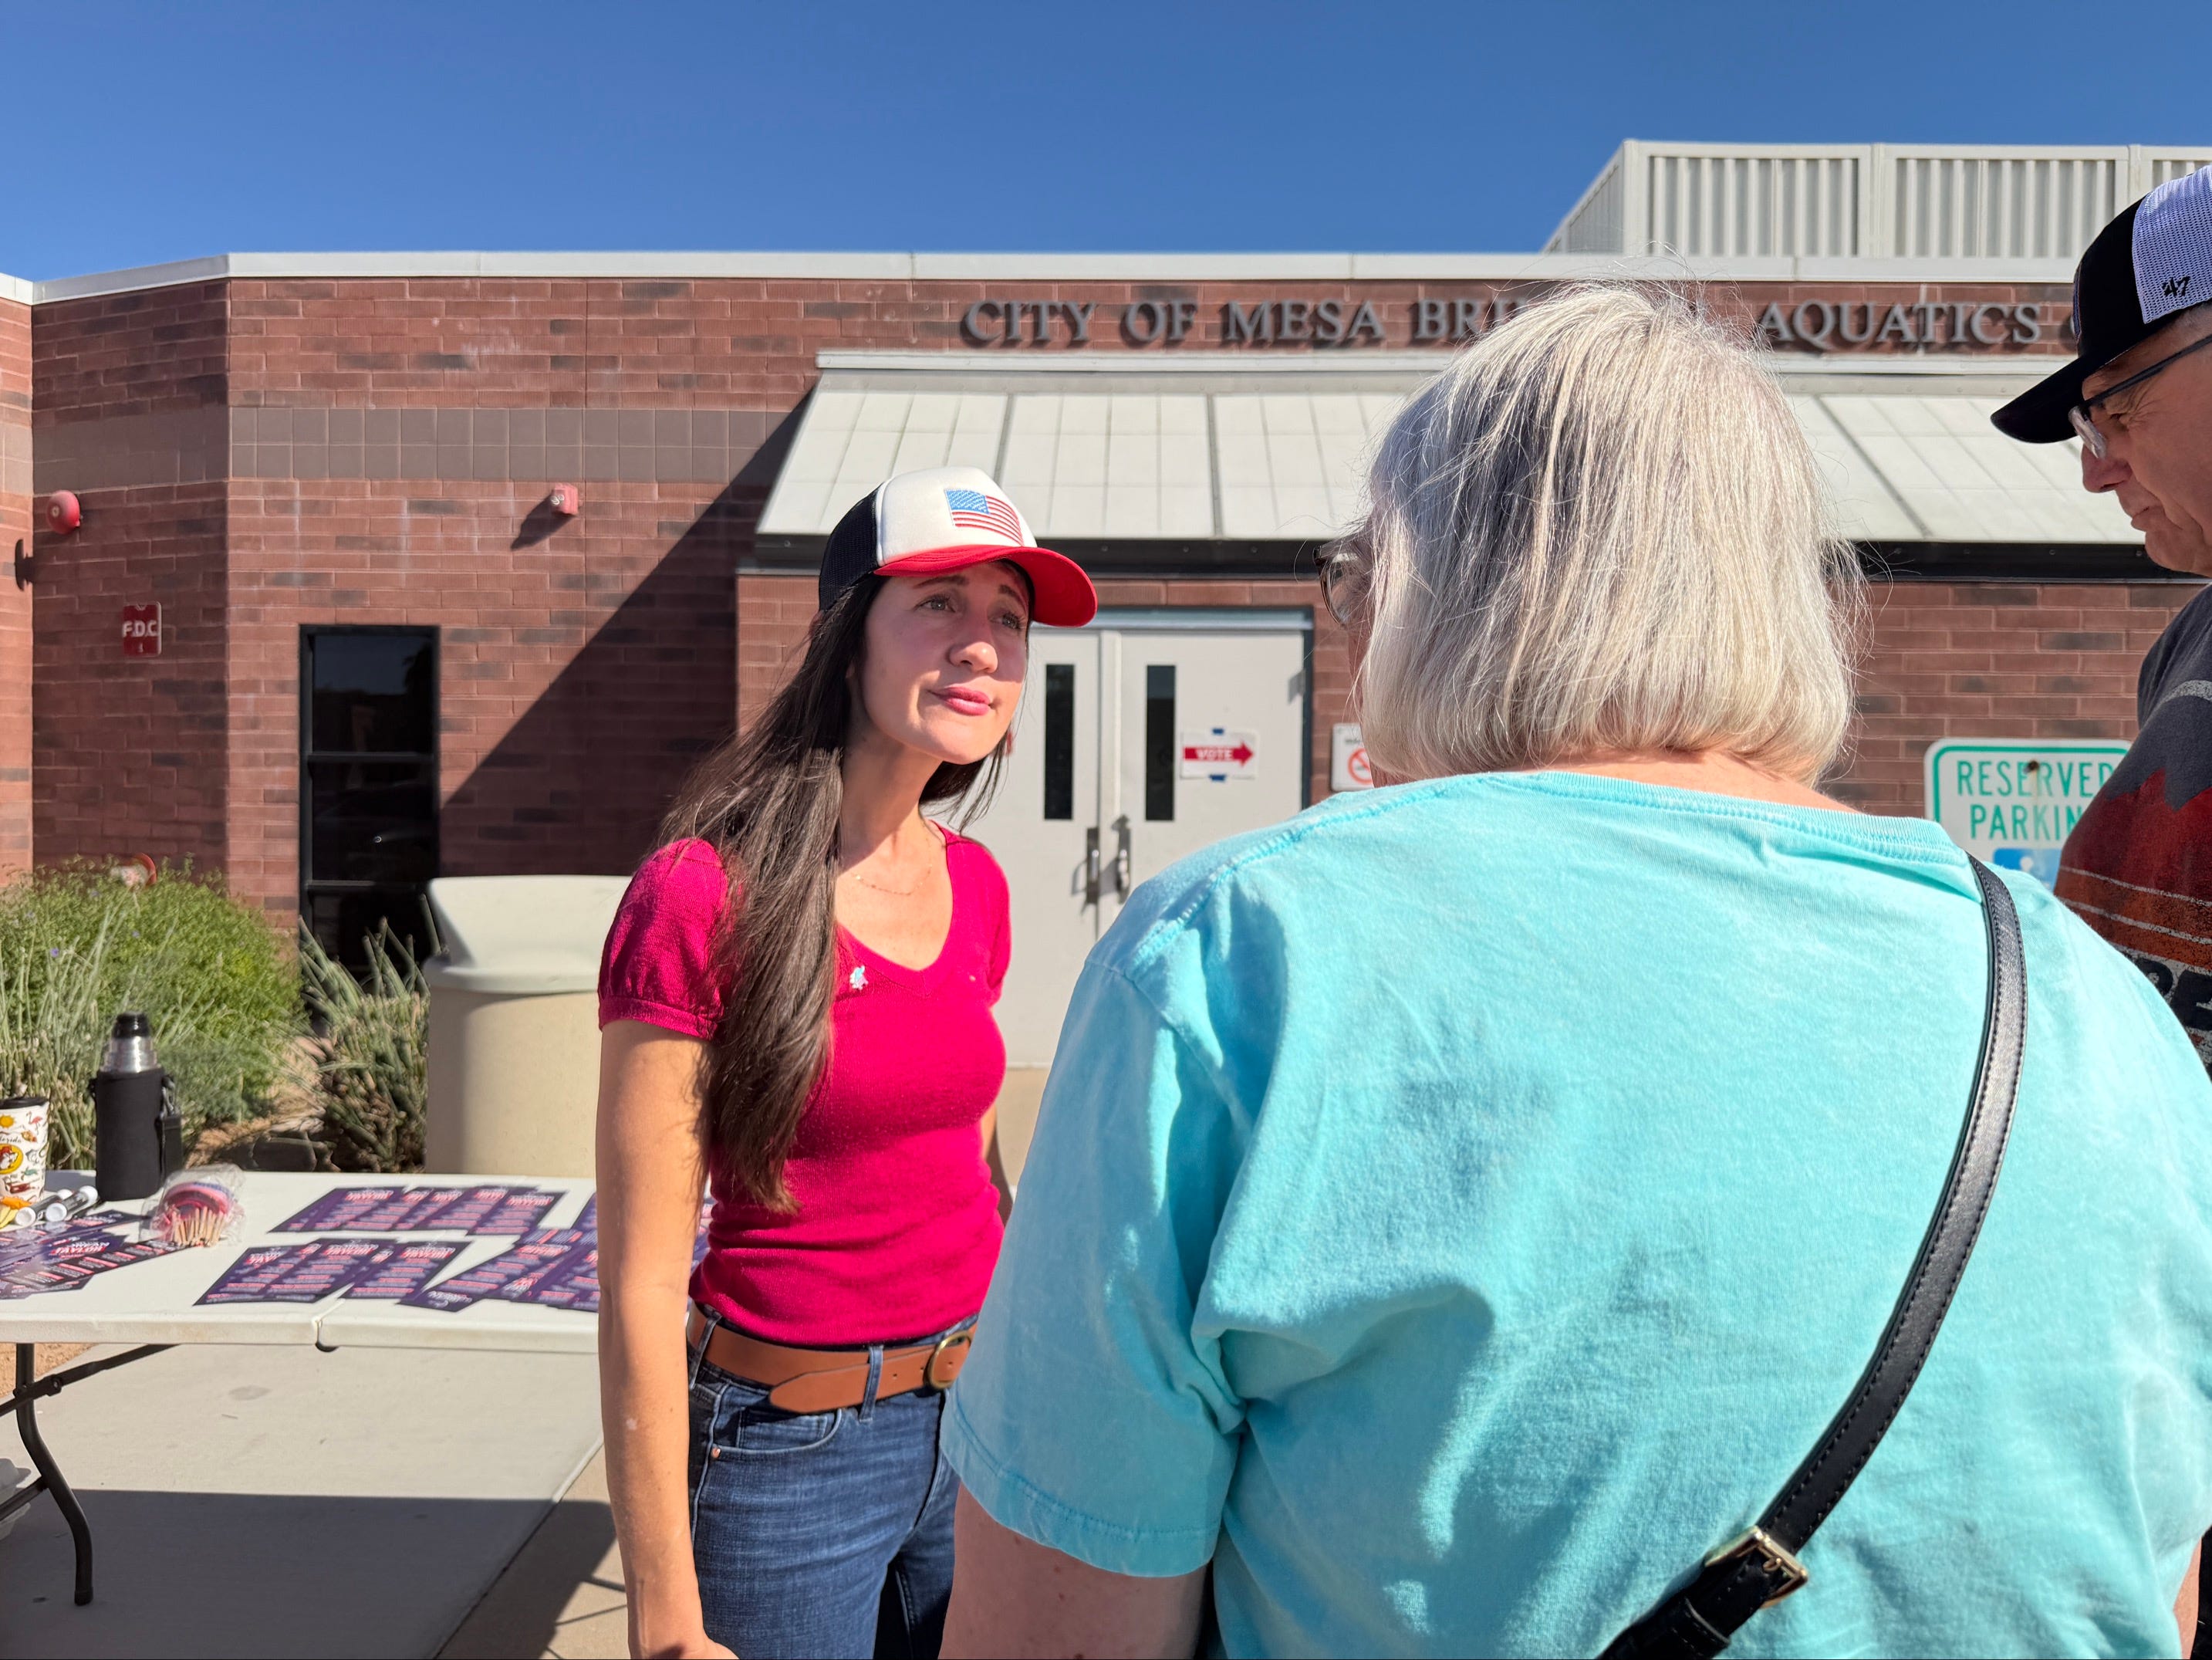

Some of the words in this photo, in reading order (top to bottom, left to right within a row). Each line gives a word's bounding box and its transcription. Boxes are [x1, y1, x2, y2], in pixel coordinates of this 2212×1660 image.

[964, 299, 1099, 341] CITY
[1124, 299, 1197, 342] OF
[1226, 299, 1386, 341] MESA
[1760, 299, 2042, 351] AQUATICS
[1196, 749, 1233, 761] VOTE
[1957, 760, 2114, 798] RESERVED
[1970, 804, 2082, 841] PARKIN
